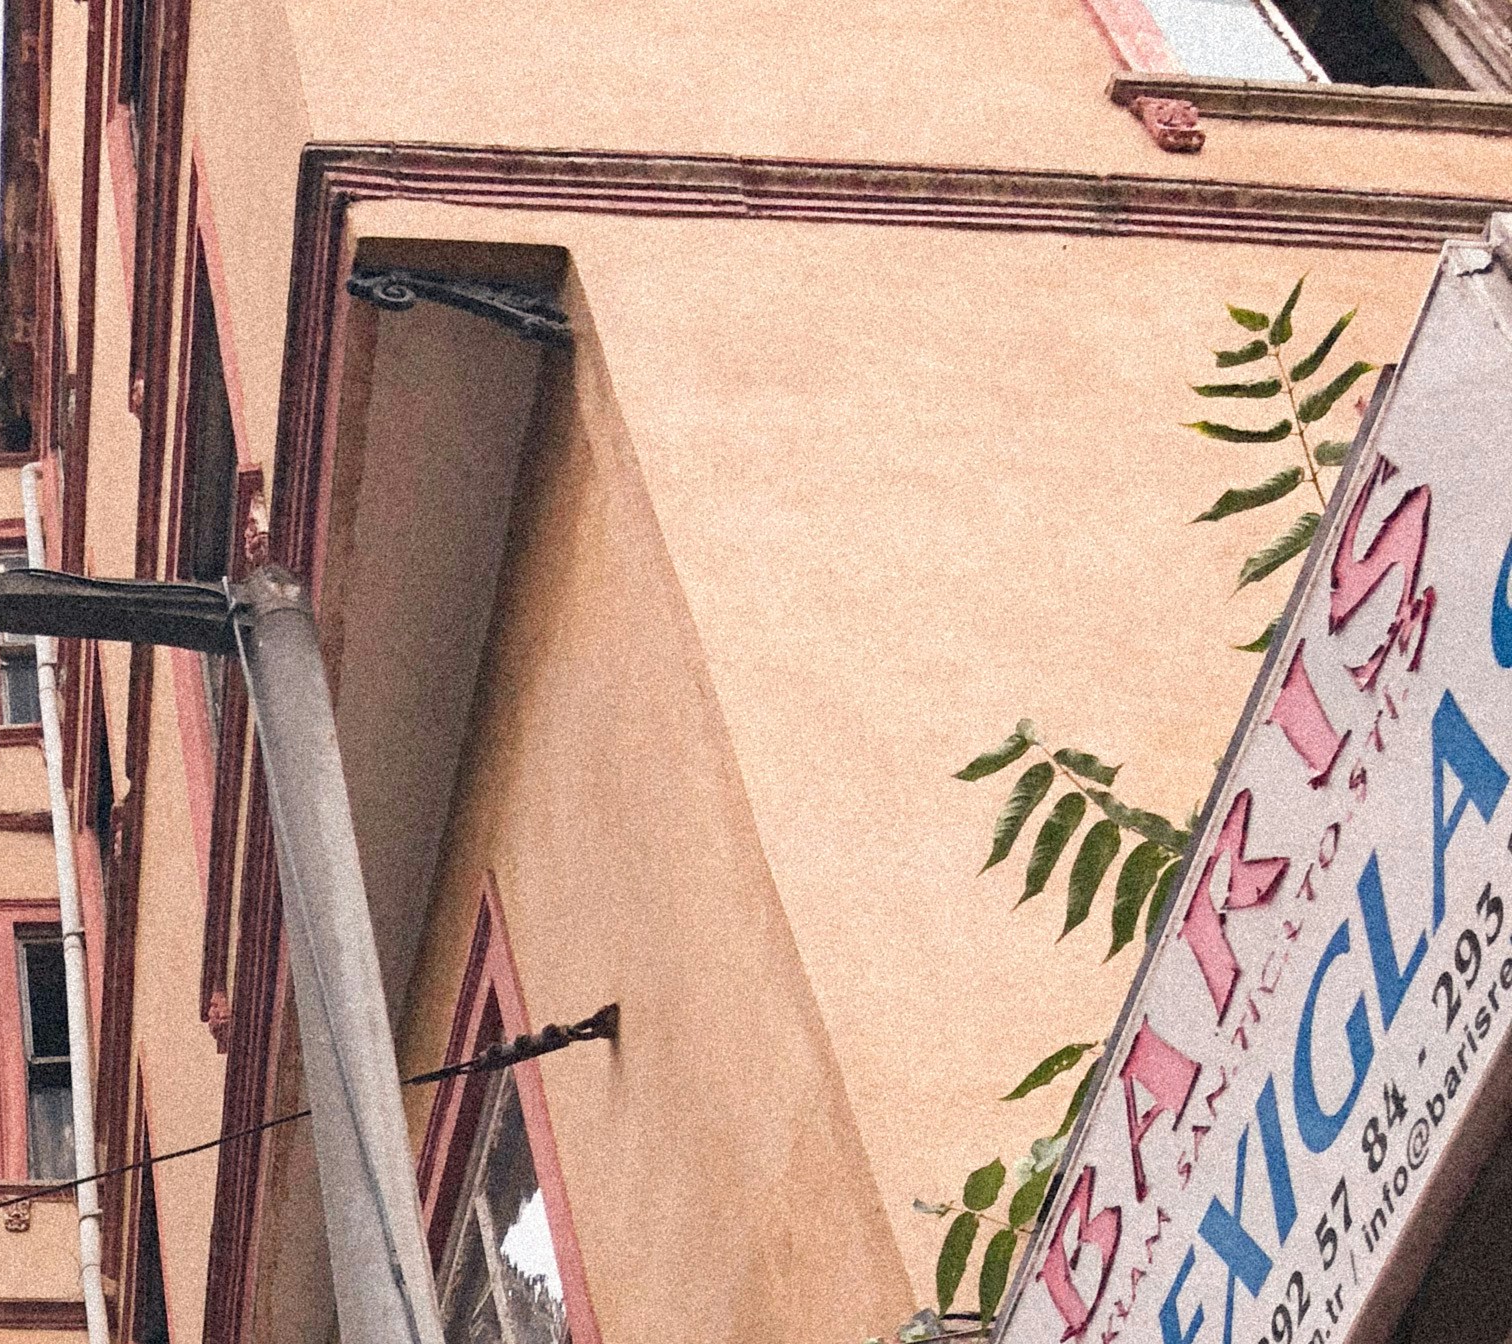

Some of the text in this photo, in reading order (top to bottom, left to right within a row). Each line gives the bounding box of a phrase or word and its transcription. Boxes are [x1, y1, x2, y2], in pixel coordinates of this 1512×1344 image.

[1314, 1174, 1358, 1272] 57
[1361, 1076, 1410, 1175] 84
[1431, 881, 1505, 1035] 293
[1362, 930, 1512, 1255] info@barisre
